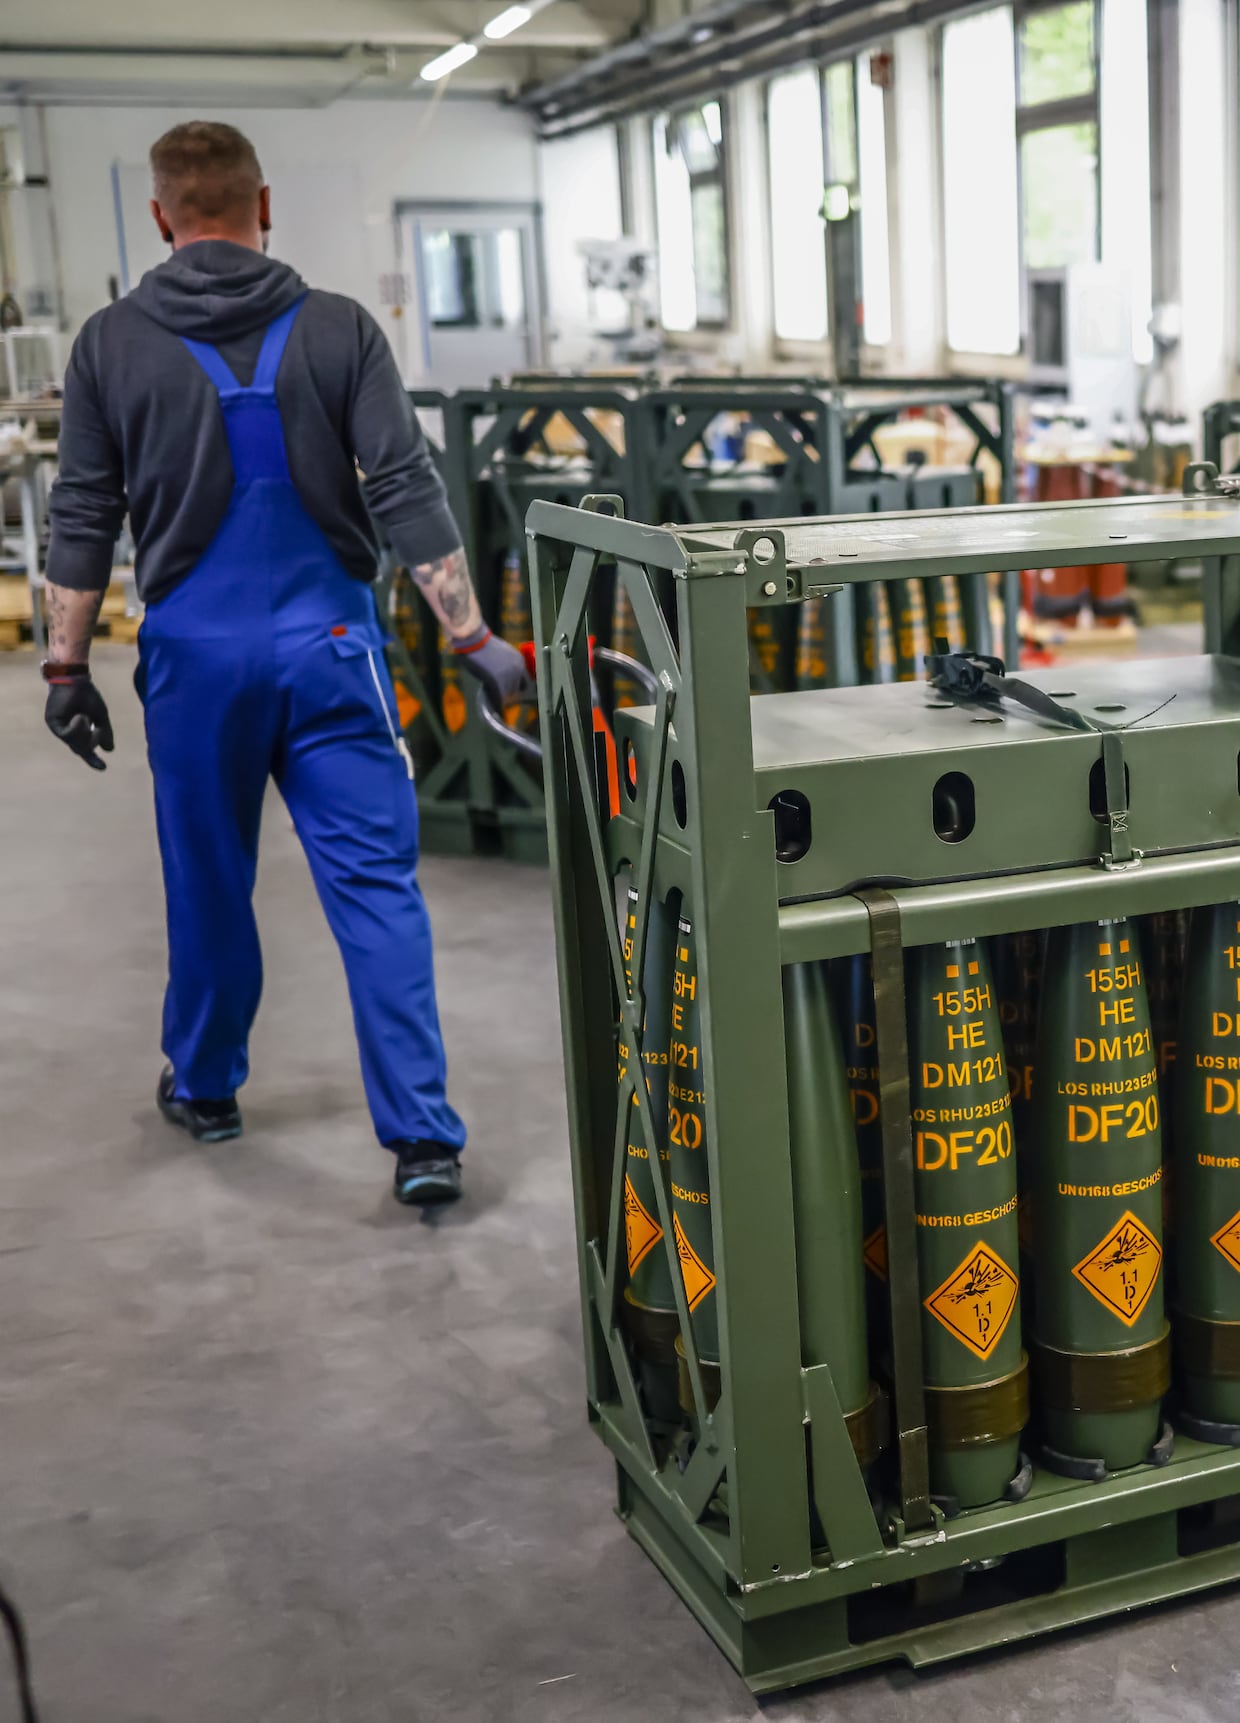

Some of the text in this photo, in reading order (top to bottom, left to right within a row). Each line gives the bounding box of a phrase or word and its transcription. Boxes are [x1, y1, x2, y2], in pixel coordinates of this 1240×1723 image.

[1084, 962, 1141, 993] 155H
[932, 983, 992, 1017] 155H
[1100, 997, 1136, 1026] HE
[947, 1020, 986, 1051] HE
[1074, 1028, 1151, 1063] DM121
[922, 1052, 1003, 1089] DM121
[1195, 1053, 1226, 1070] LOS
[1057, 1081, 1089, 1096] LOS
[913, 1108, 937, 1123] OS
[1068, 1094, 1159, 1143] DF20
[670, 1107, 703, 1149] 20
[917, 1120, 1012, 1171] DF20
[1197, 1153, 1215, 1168] UN
[1058, 1183, 1077, 1197] UN
[1077, 1185, 1111, 1197] 0168
[928, 1215, 962, 1228] 0168
[1119, 1268, 1139, 1285] 1.1
[1124, 1285, 1136, 1300] D
[972, 1300, 993, 1318] 1.1
[978, 1318, 990, 1333] D
